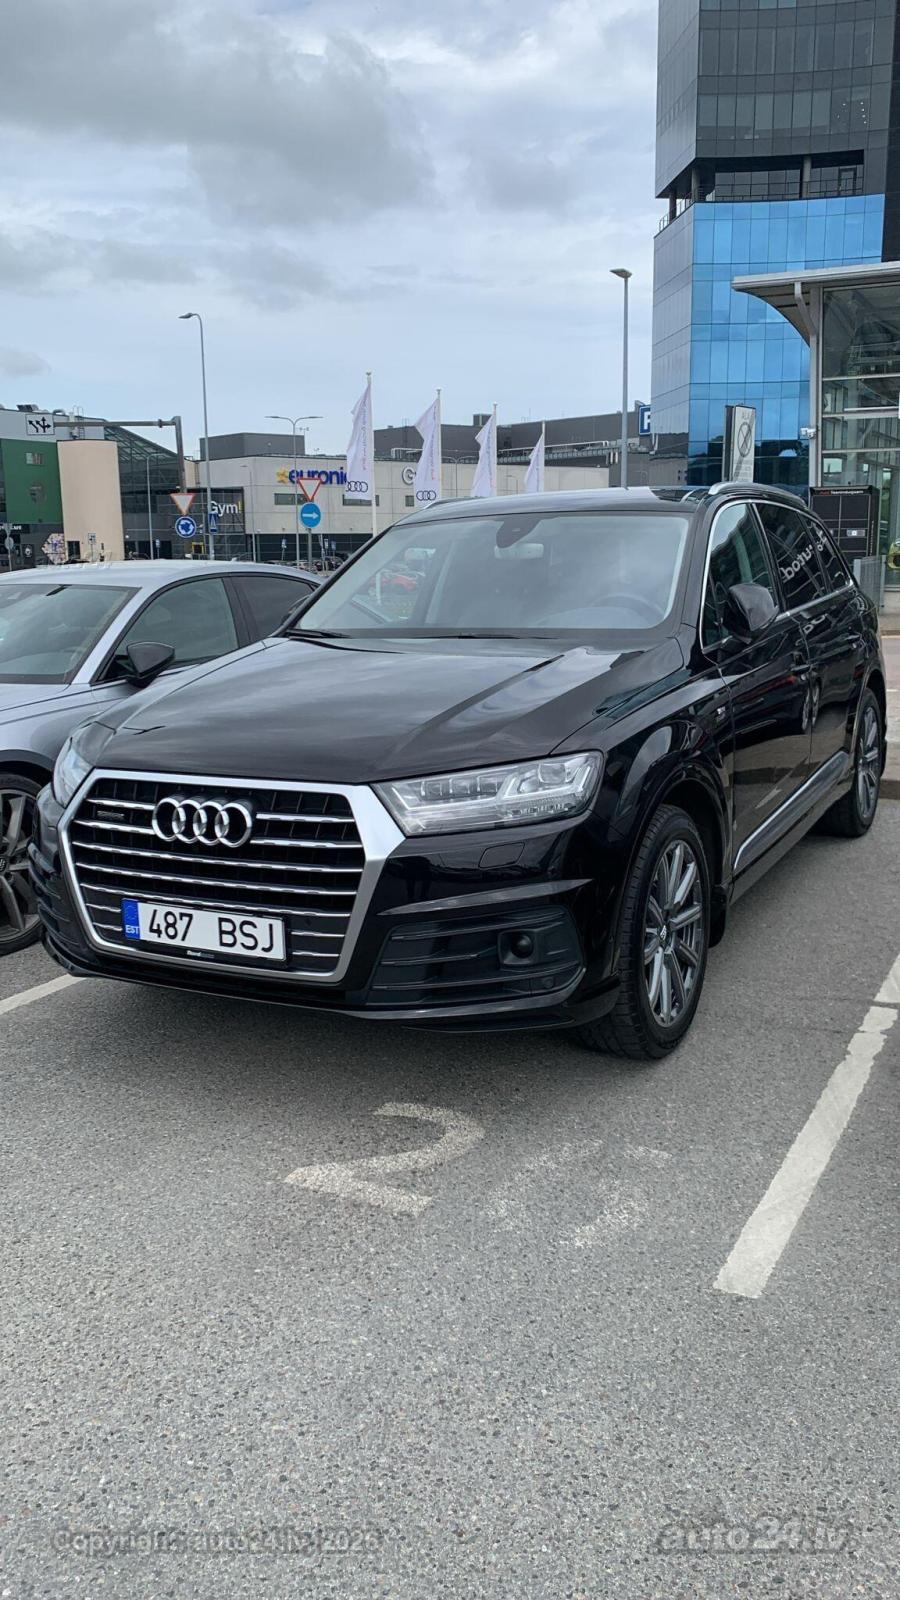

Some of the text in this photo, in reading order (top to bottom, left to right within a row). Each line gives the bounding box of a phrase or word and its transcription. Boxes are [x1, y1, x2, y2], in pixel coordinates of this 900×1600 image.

[209, 500, 242, 517] Gym!
[125, 925, 139, 935] EST
[148, 909, 275, 953] 487 BSJ
